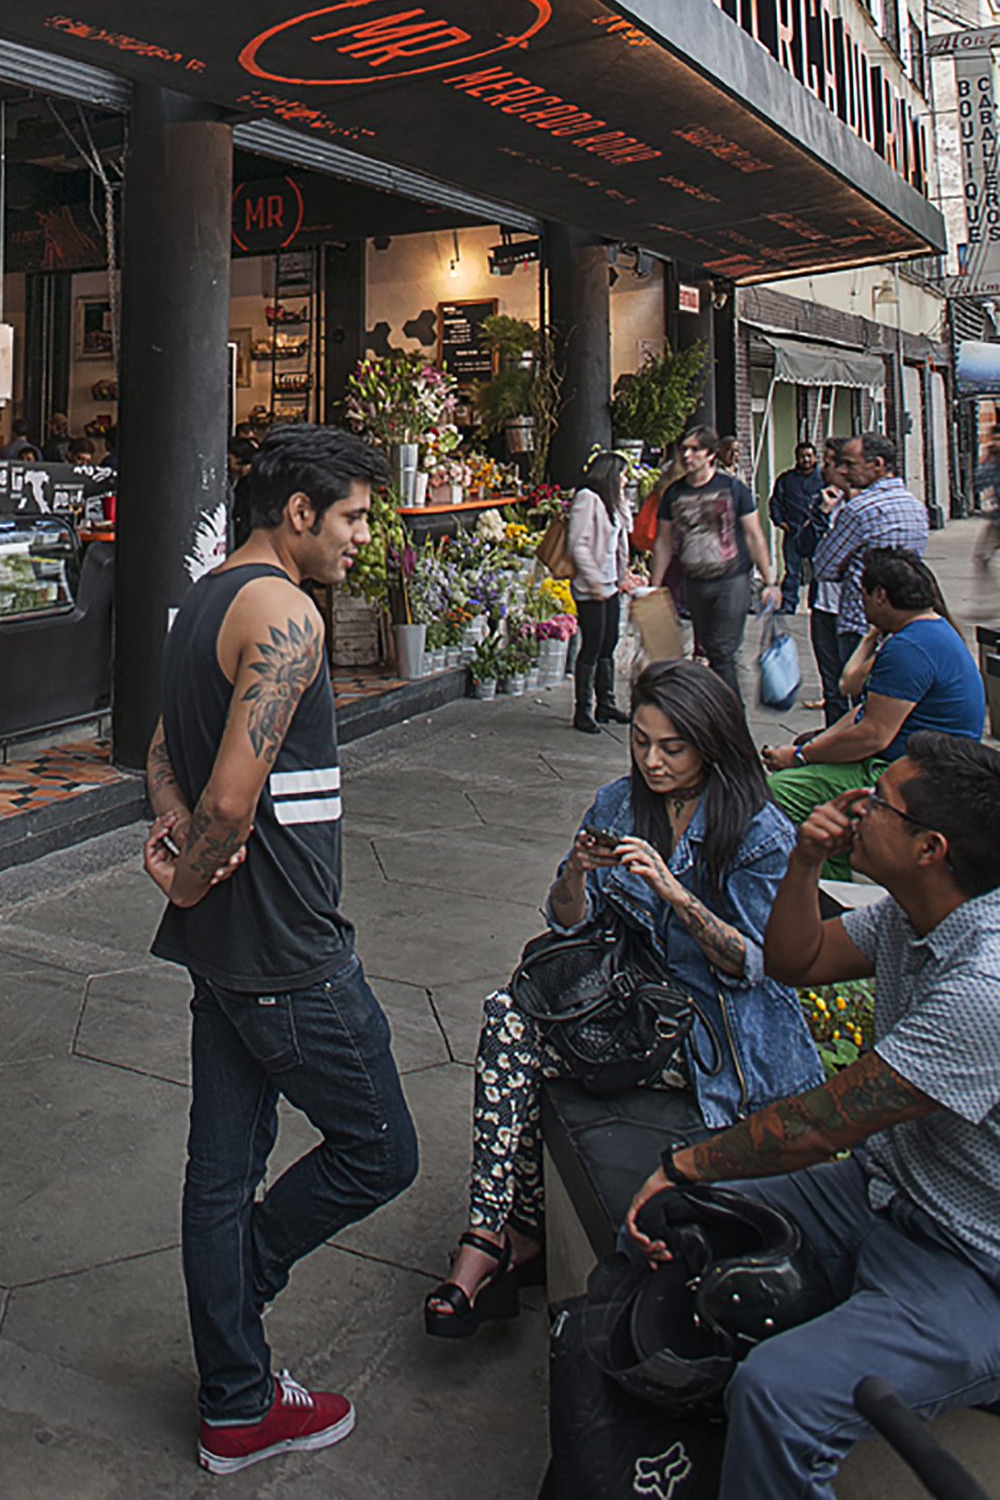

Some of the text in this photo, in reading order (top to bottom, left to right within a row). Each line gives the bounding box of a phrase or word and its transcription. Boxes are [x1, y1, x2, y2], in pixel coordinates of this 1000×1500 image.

[310, 8, 472, 67] MR
[442, 65, 662, 165] MERCADO ROMA
[958, 79, 981, 243] BOUTIQUE
[977, 76, 1000, 242] CABALLEROS
[245, 195, 284, 230] MR
